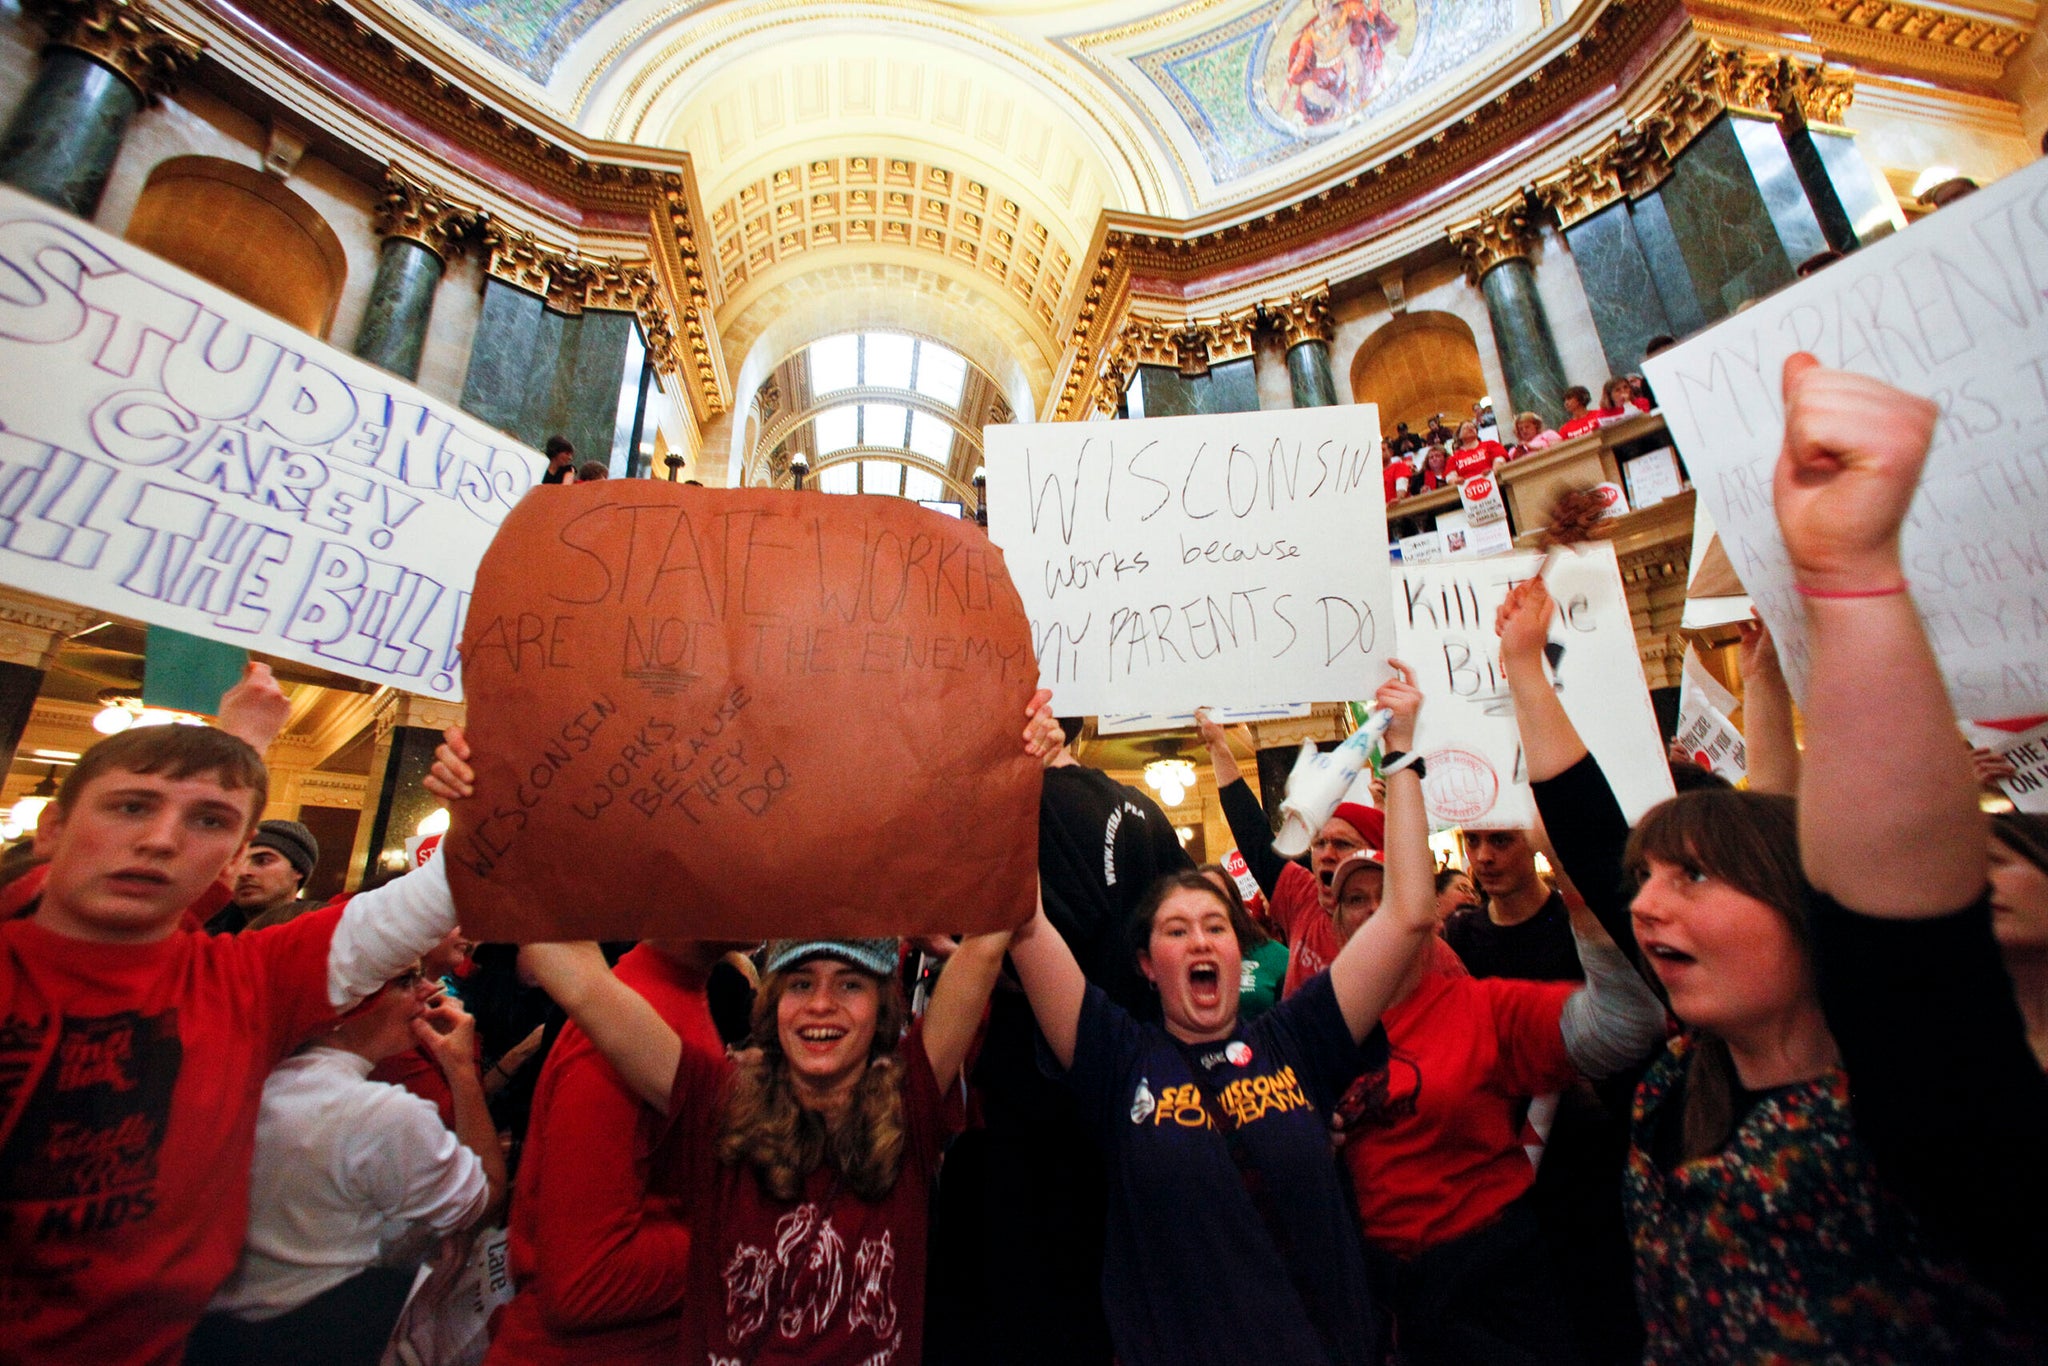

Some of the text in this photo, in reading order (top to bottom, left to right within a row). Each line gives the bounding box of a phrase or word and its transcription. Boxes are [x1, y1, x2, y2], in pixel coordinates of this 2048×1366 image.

[0, 219, 531, 526] STUDENTS
[89, 388, 424, 551] CARE!
[1026, 437, 1372, 545] WISCONSIN
[1465, 480, 1491, 497] STOP
[0, 421, 472, 692] ILL THE BILL!
[548, 502, 796, 621] STATE
[1180, 533, 1301, 565] because
[462, 613, 1028, 684] ARE NOT THE ENEMY!
[1030, 586, 1376, 684] MY PARENTS DO
[453, 692, 618, 878] WISCONSIN
[571, 716, 676, 821] WORKS
[629, 684, 752, 818] BECAUSE
[671, 739, 748, 825] THEY
[2003, 742, 2045, 768] THE
[2009, 771, 2043, 794] ON
[1104, 805, 1122, 886] WWW.VETERA
[1228, 857, 1245, 873] STO
